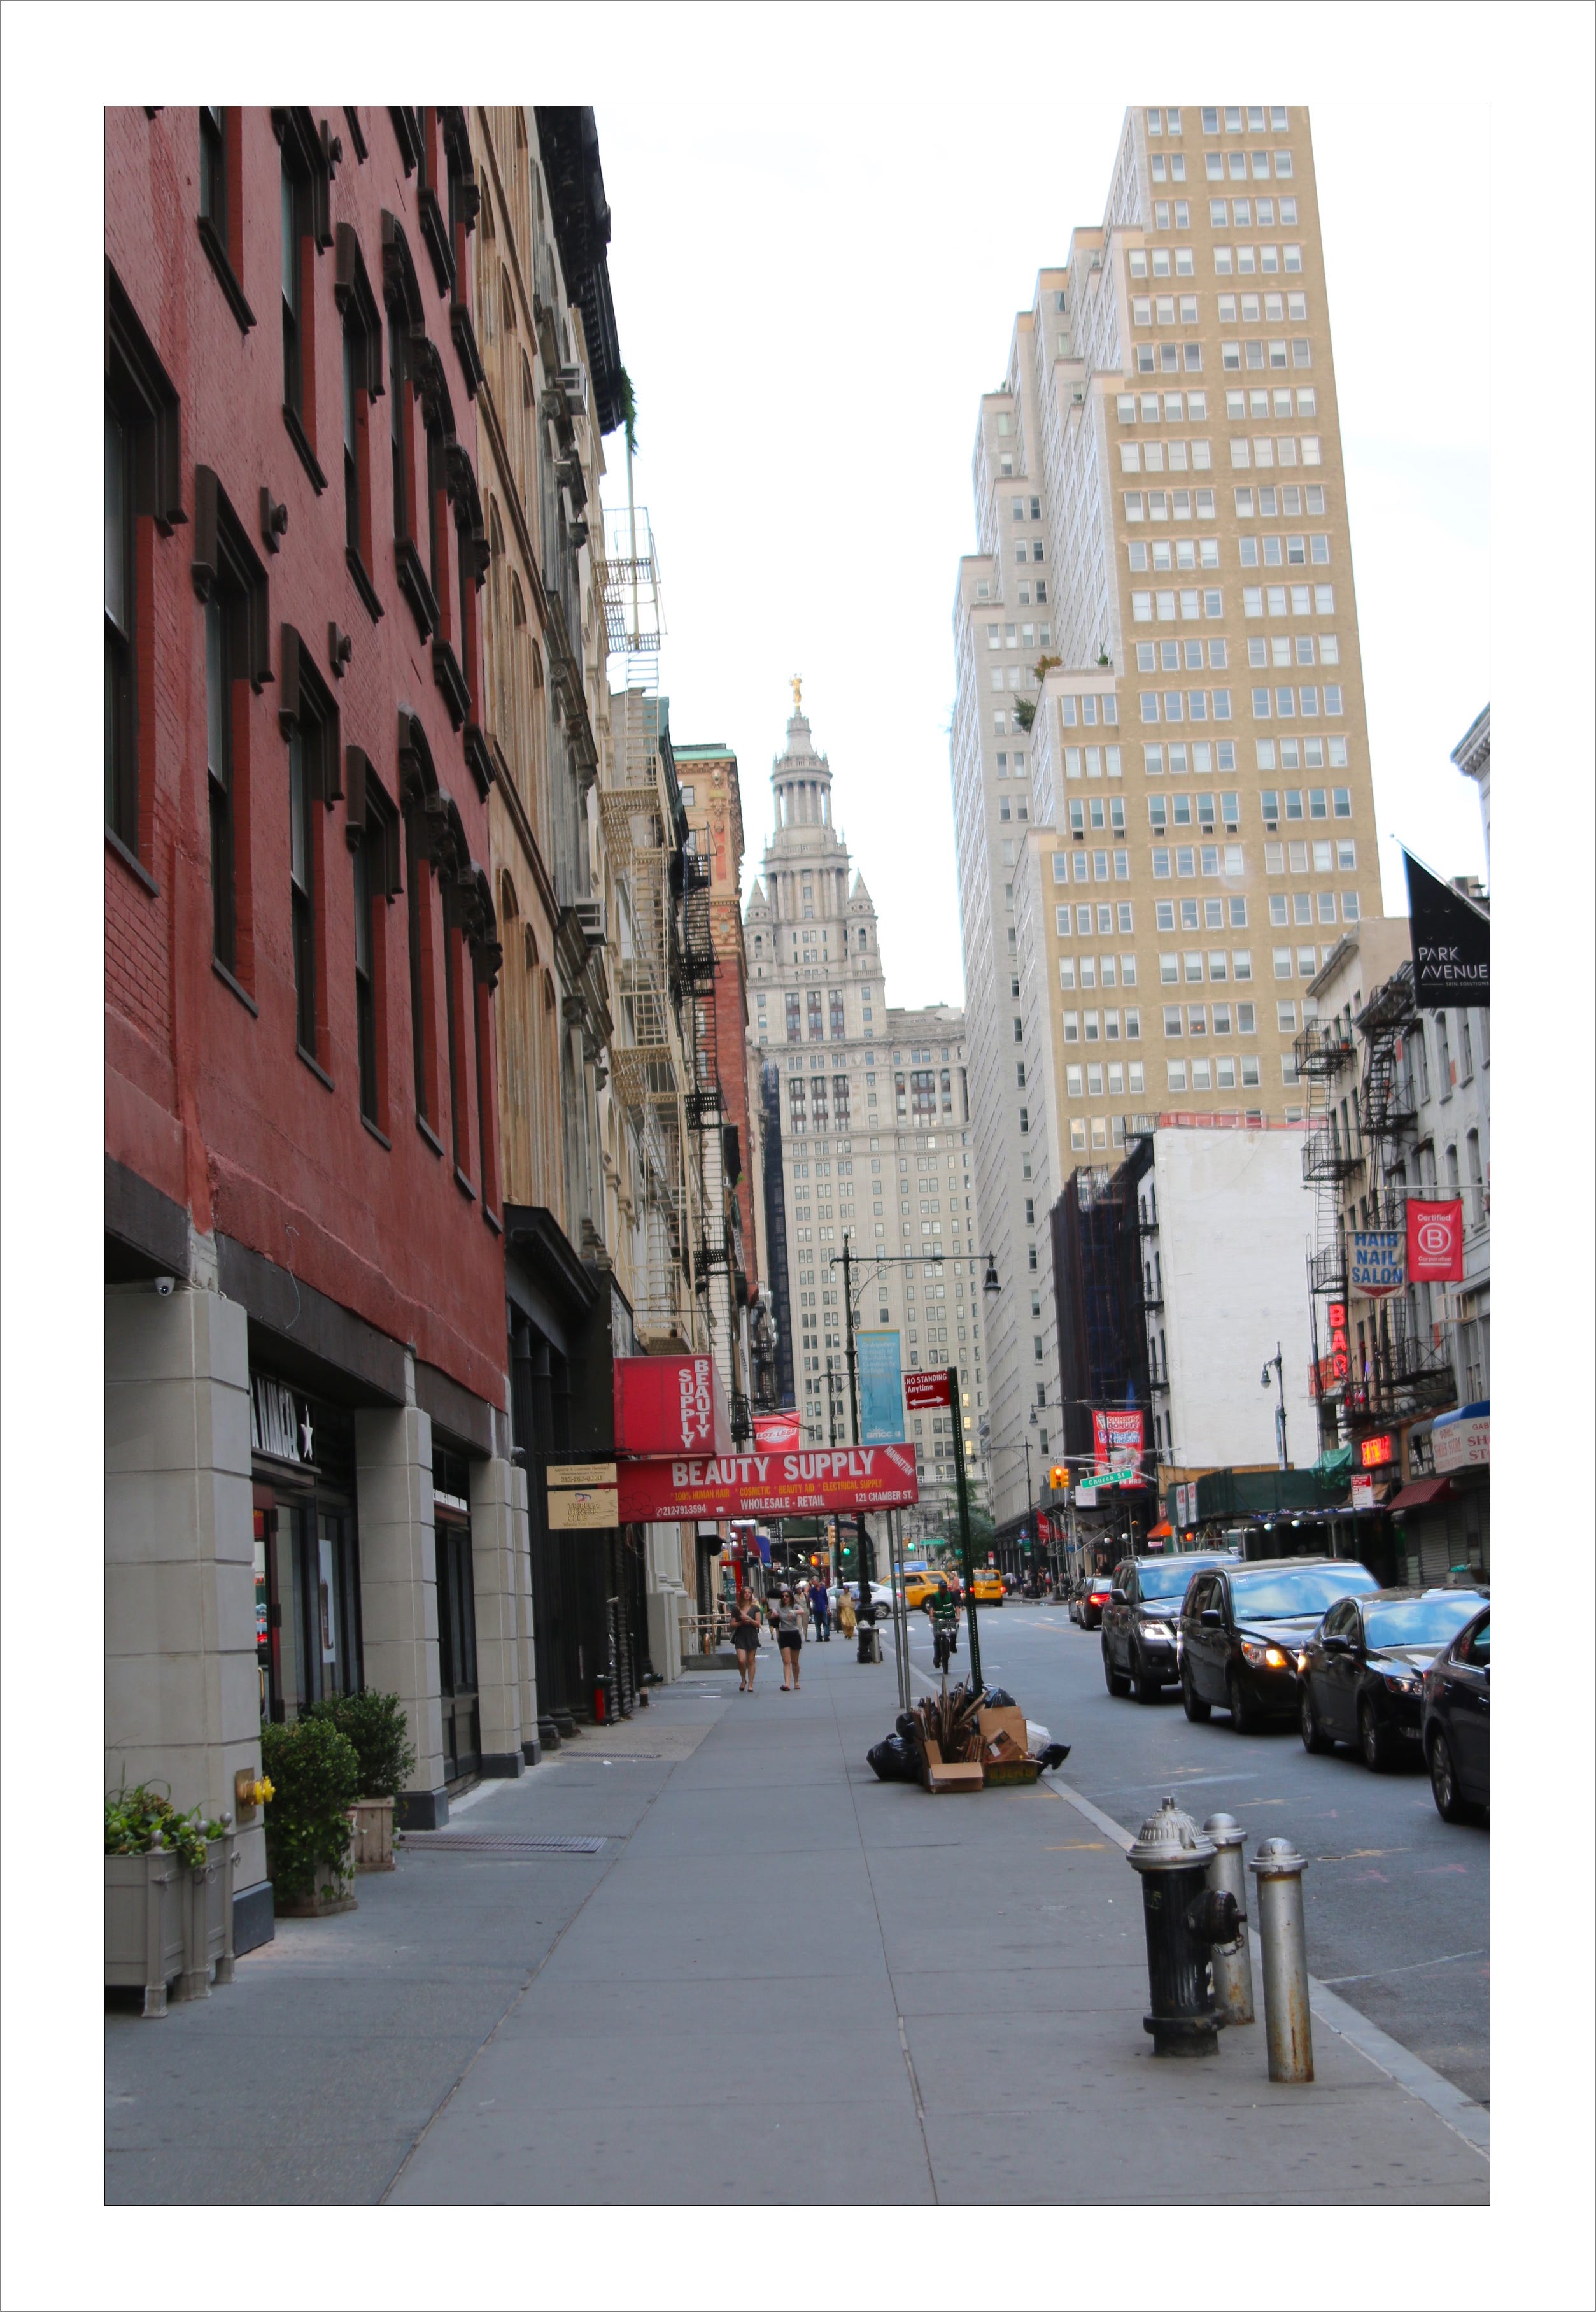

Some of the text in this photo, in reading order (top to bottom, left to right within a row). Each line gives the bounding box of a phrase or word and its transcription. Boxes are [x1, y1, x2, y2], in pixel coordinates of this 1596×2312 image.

[1418, 947, 1462, 962] PARK
[1421, 965, 1488, 979] AVENUE
[1355, 1232, 1398, 1247] HAIR
[1427, 1229, 1443, 1249] B
[1357, 1249, 1397, 1266] NAIL
[1352, 1267, 1403, 1284] SALON
[1329, 1303, 1348, 1378] BAR
[917, 1373, 947, 1383] STANDING
[907, 1384, 933, 1393] Anytime
[695, 1359, 710, 1438] BEAUTY
[678, 1369, 695, 1448] SUPPLY
[758, 1428, 796, 1438] LOT-LESS
[672, 1449, 875, 1487] BEAUTY SUPPLY
[884, 1445, 914, 1476] MANHATTAN
[1089, 1475, 1114, 1486] Church
[675, 1479, 882, 1501] 100% HUMAN HAIR COSMETIC BEAUTY AID ELECTRICAL SUPPLY
[855, 1490, 913, 1502] 121 CHAMBER ST.
[663, 1503, 707, 1516] 212-791-3594
[740, 1497, 790, 1510] WHOLESALE
[798, 1495, 824, 1507] RETAIL
